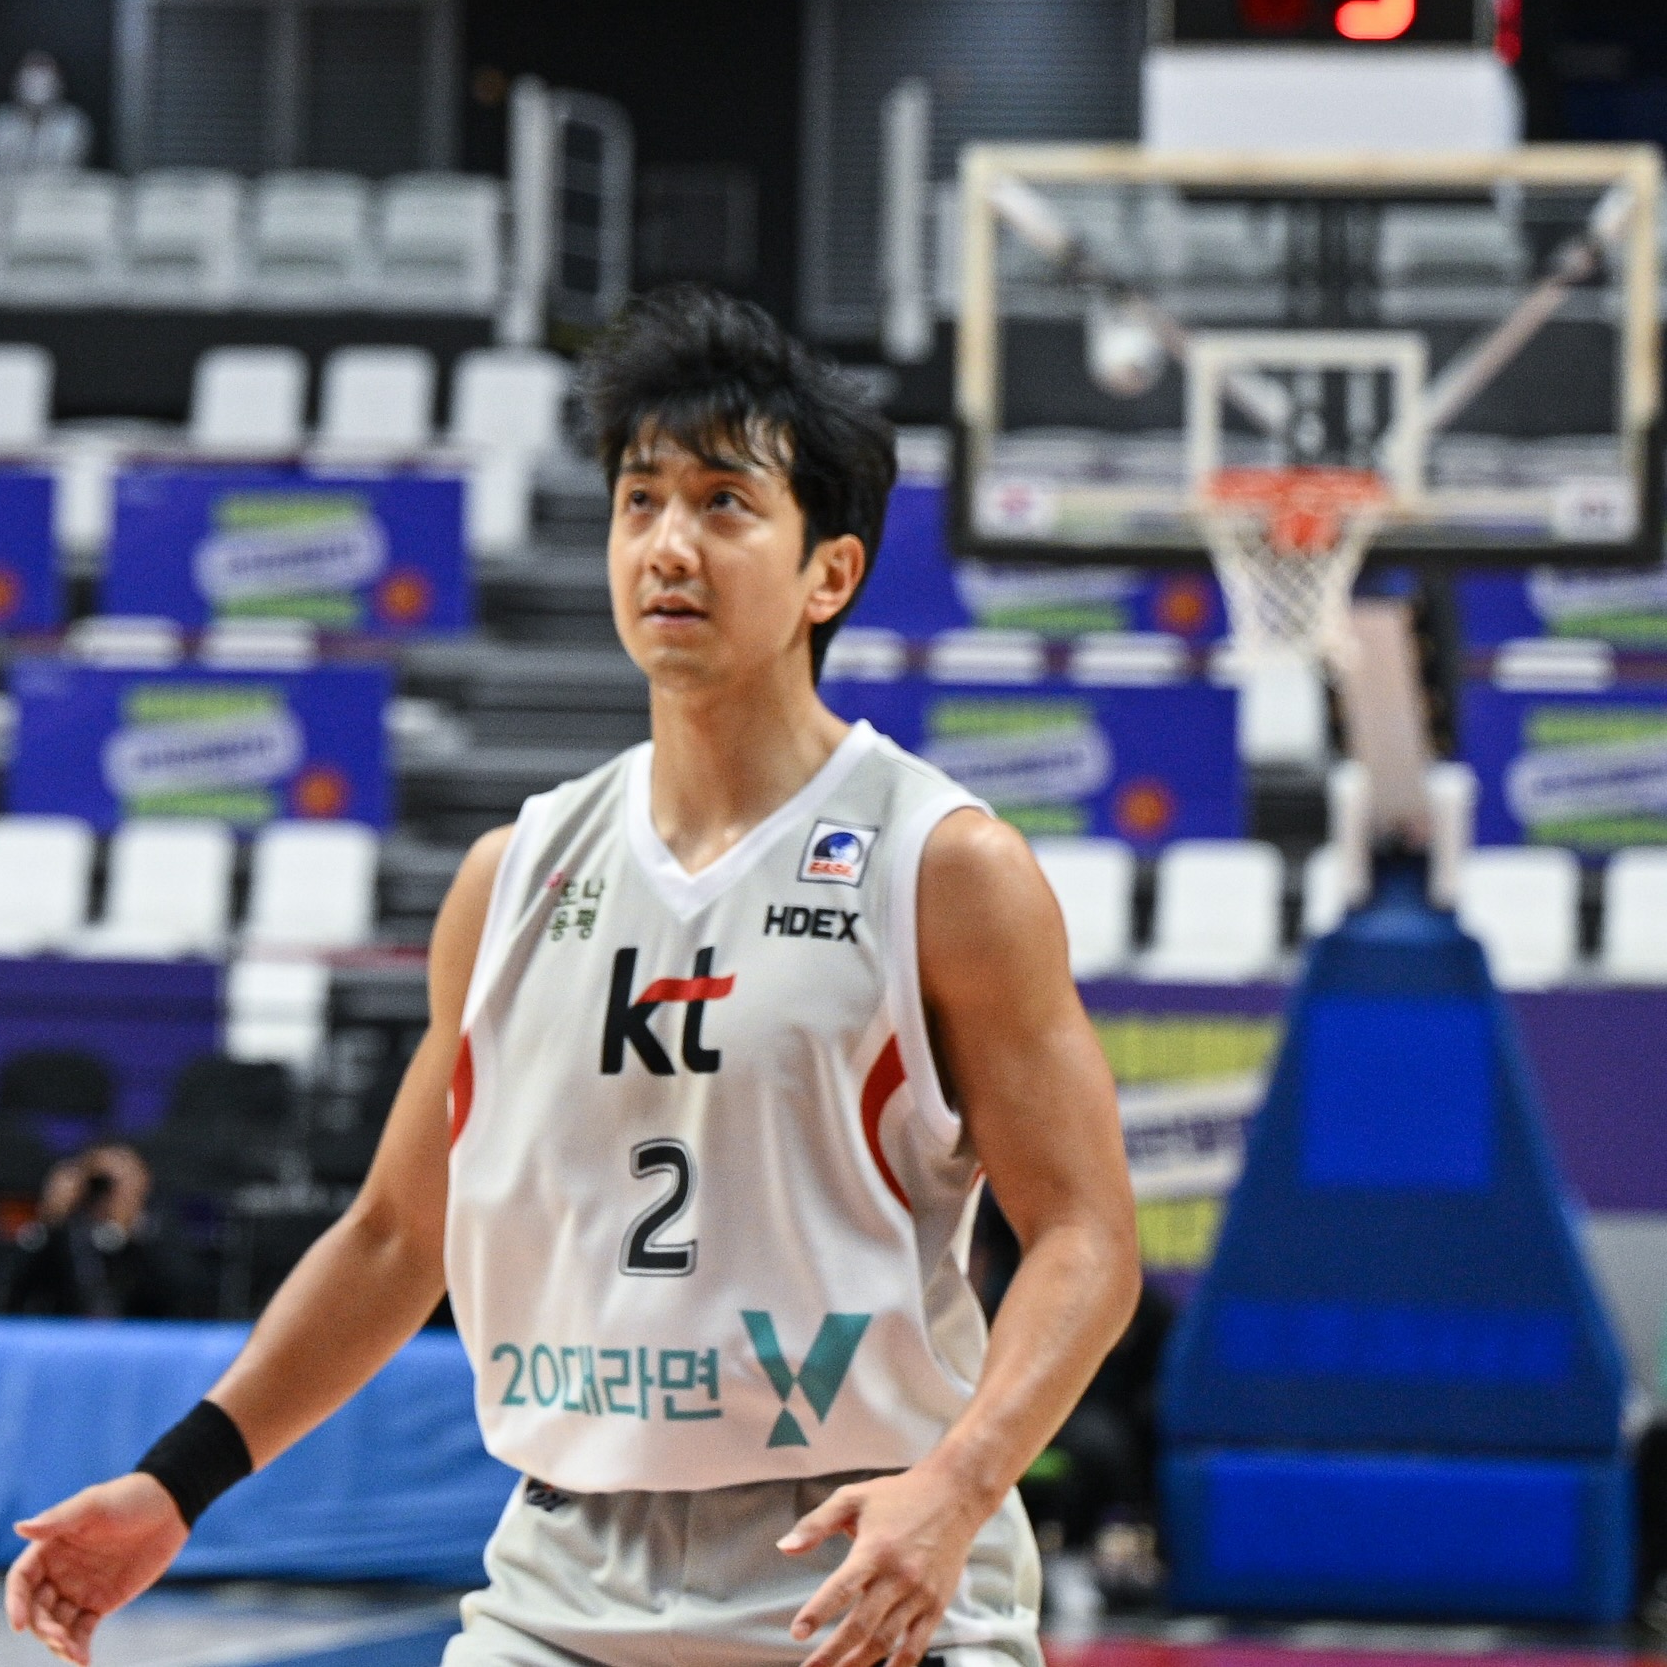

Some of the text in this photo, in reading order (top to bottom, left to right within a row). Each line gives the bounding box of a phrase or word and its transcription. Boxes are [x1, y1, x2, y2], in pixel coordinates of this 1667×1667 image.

[762, 903, 860, 945] HDEX
[600, 946, 737, 1076] kt
[618, 1137, 697, 1278] 2
[490, 1342, 724, 1421] 20대라면
